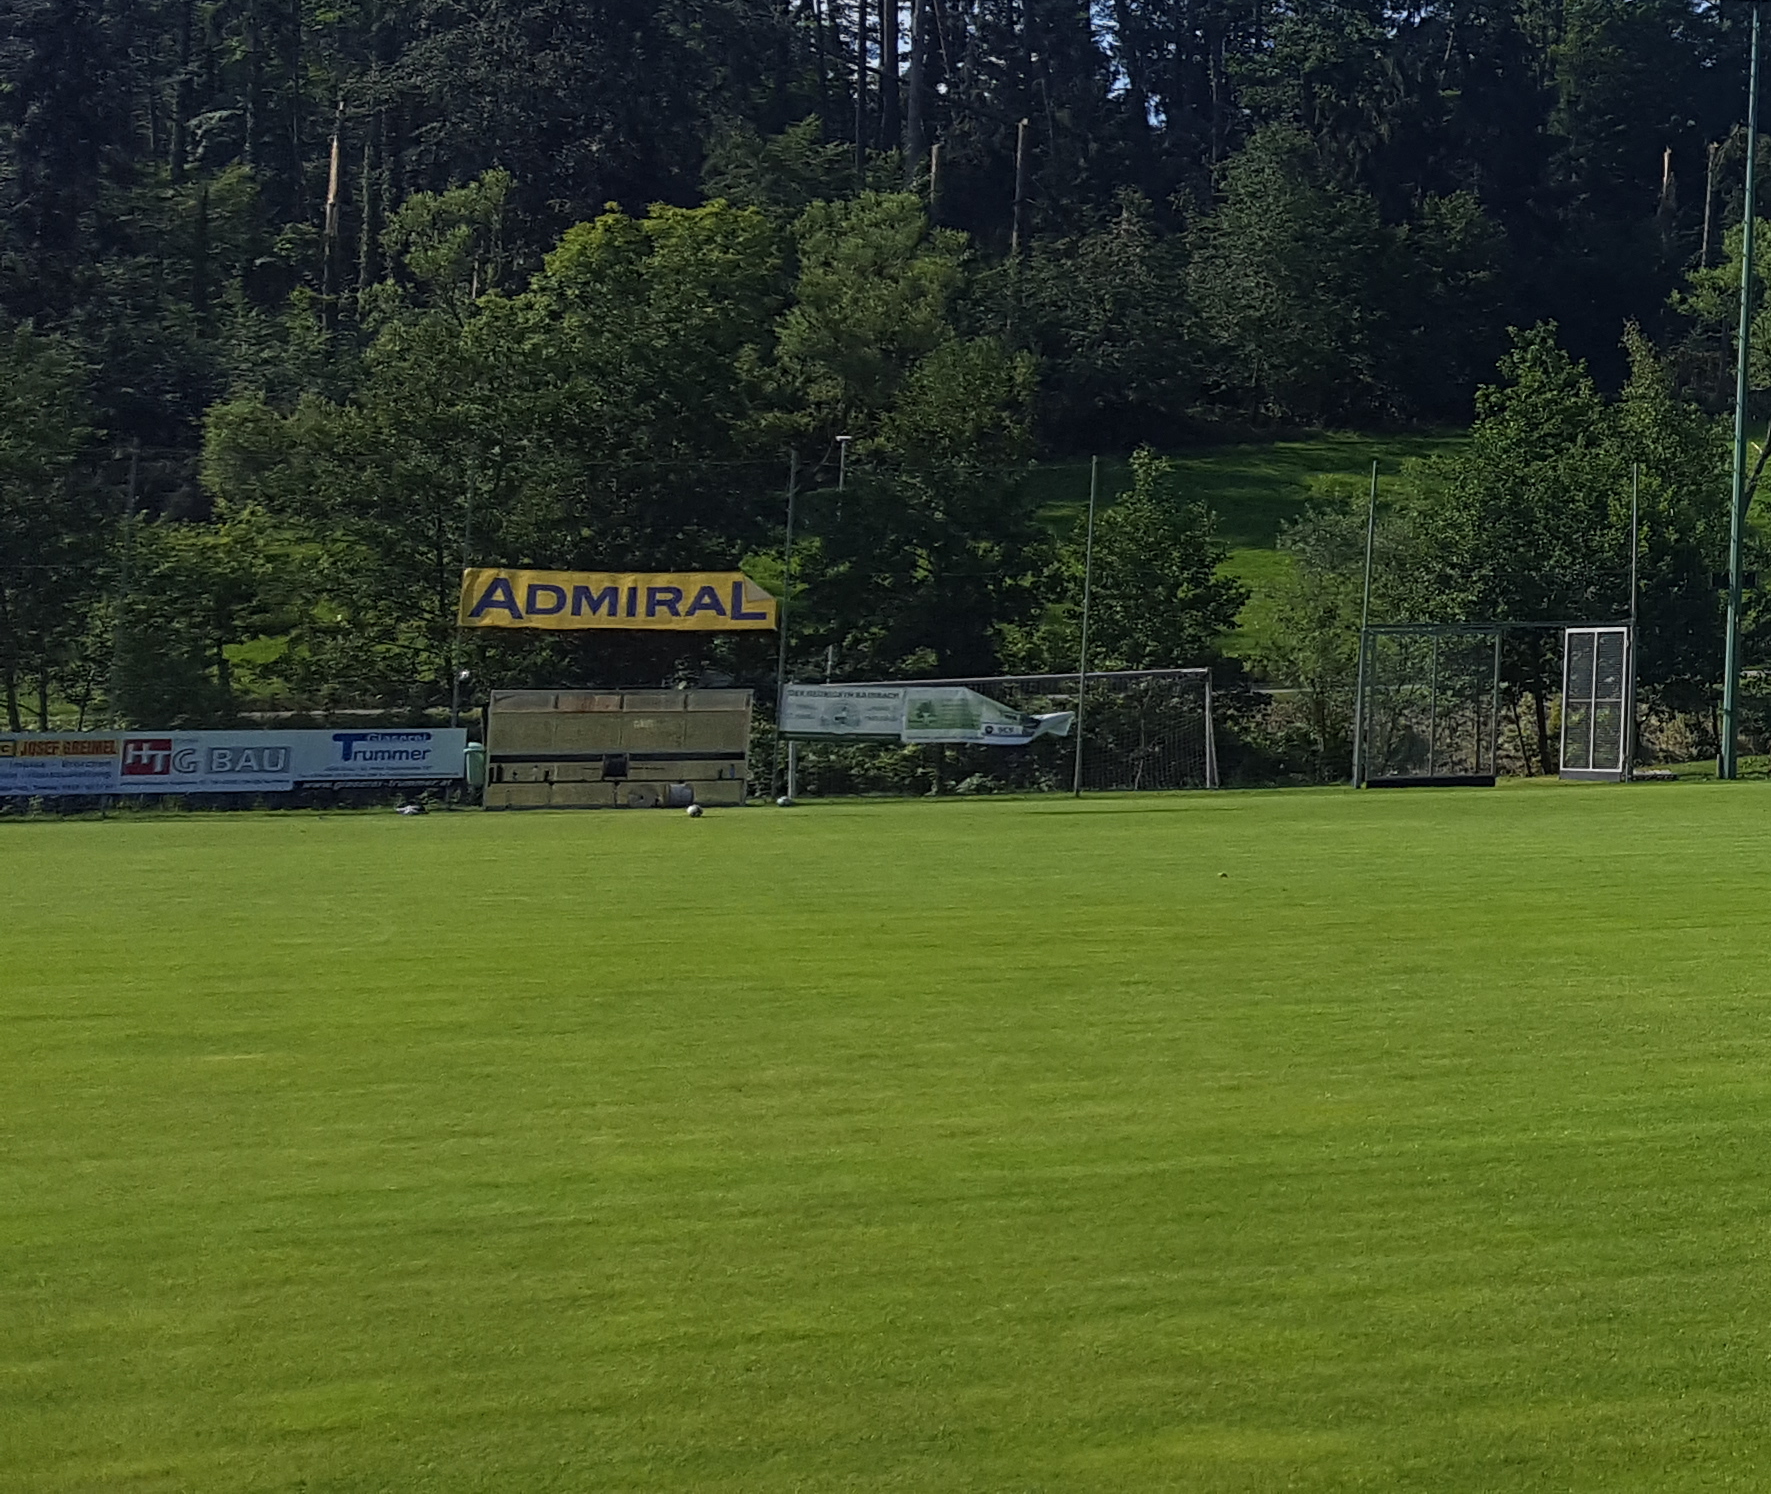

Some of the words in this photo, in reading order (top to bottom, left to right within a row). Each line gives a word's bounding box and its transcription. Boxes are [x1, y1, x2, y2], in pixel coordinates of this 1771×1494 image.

[467, 577, 767, 620] ADMIRAL
[212, 749, 286, 772] BAU
[332, 733, 432, 762] Trummer
